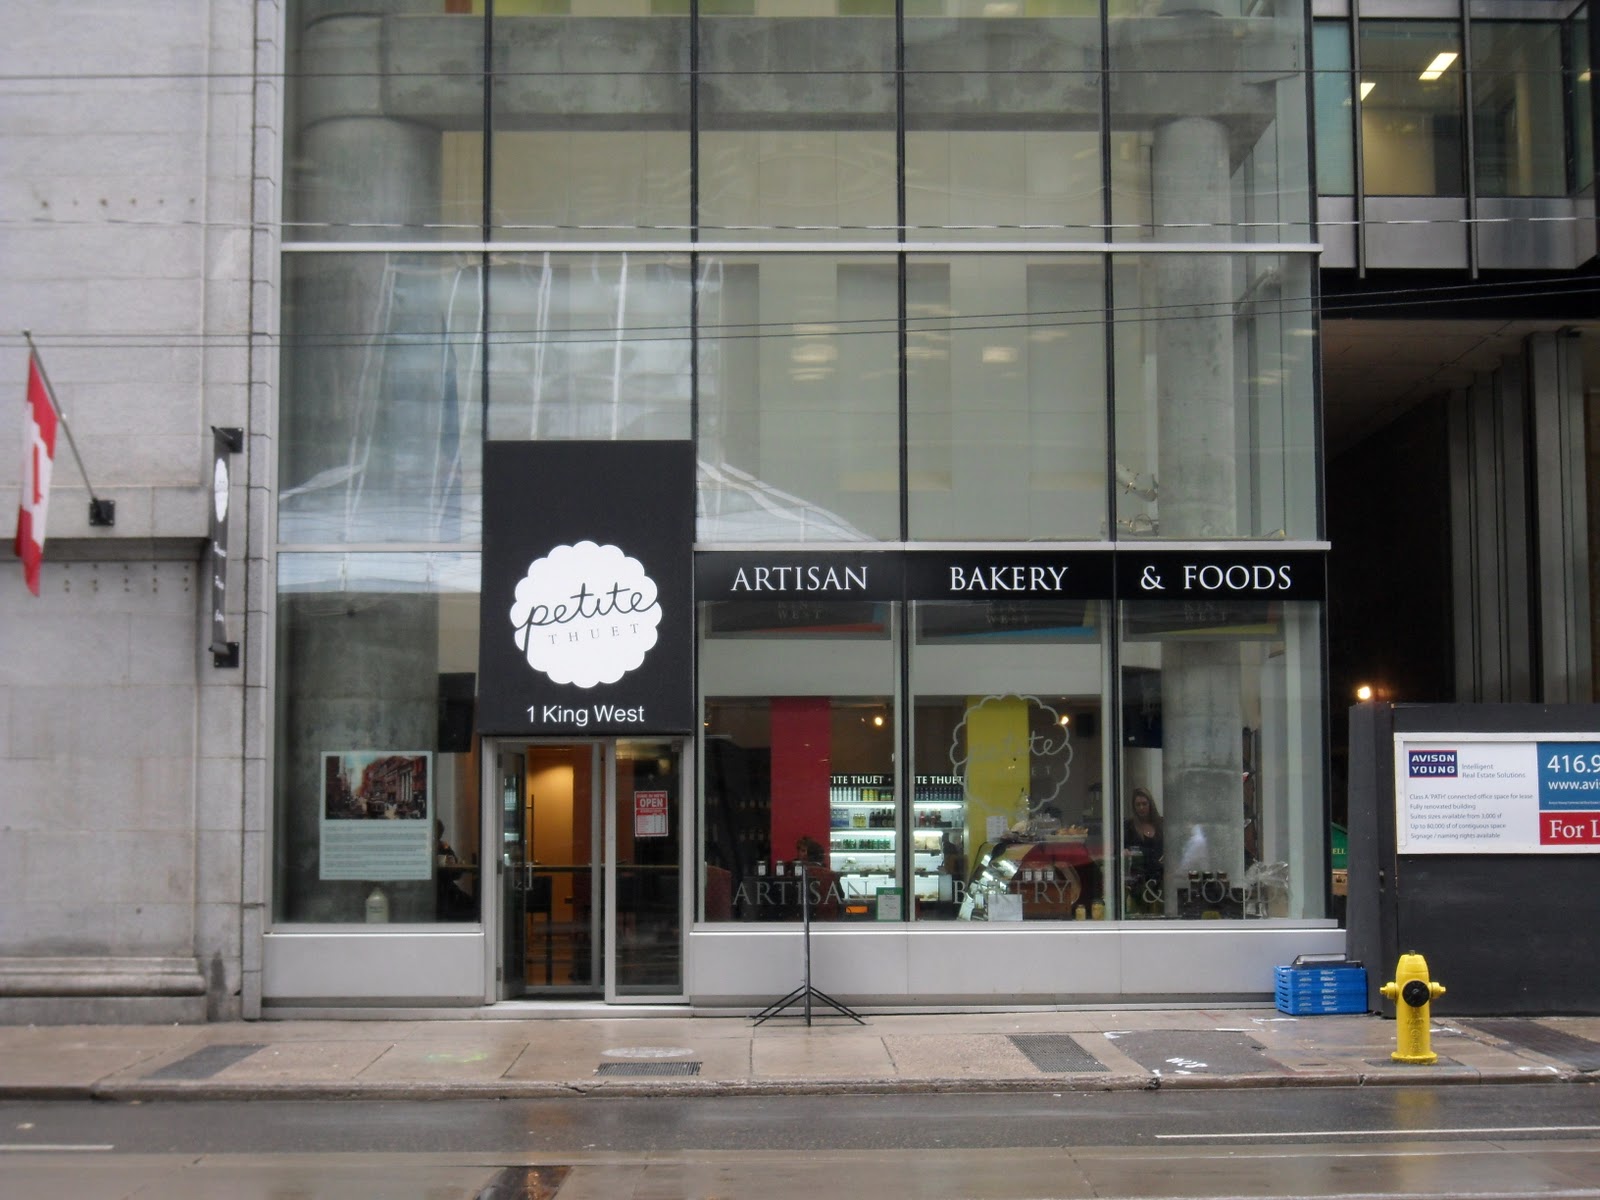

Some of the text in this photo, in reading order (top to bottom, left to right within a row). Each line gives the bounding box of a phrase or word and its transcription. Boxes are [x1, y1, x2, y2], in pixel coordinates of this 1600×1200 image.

[730, 565, 1292, 591] ARTISAN BAKERY & FOODS
[514, 582, 657, 652] petite
[548, 623, 640, 645] THUET
[526, 705, 645, 727] 1 King West
[1411, 754, 1455, 763] AVISON
[1547, 754, 1600, 774] 416.9
[1411, 765, 1456, 774] YOUNG
[1461, 763, 1494, 772] Intelligent
[850, 775, 885, 785] THUET
[1548, 779, 1600, 790] www.avi
[640, 798, 664, 808] OPEN
[1549, 819, 1585, 839] For
